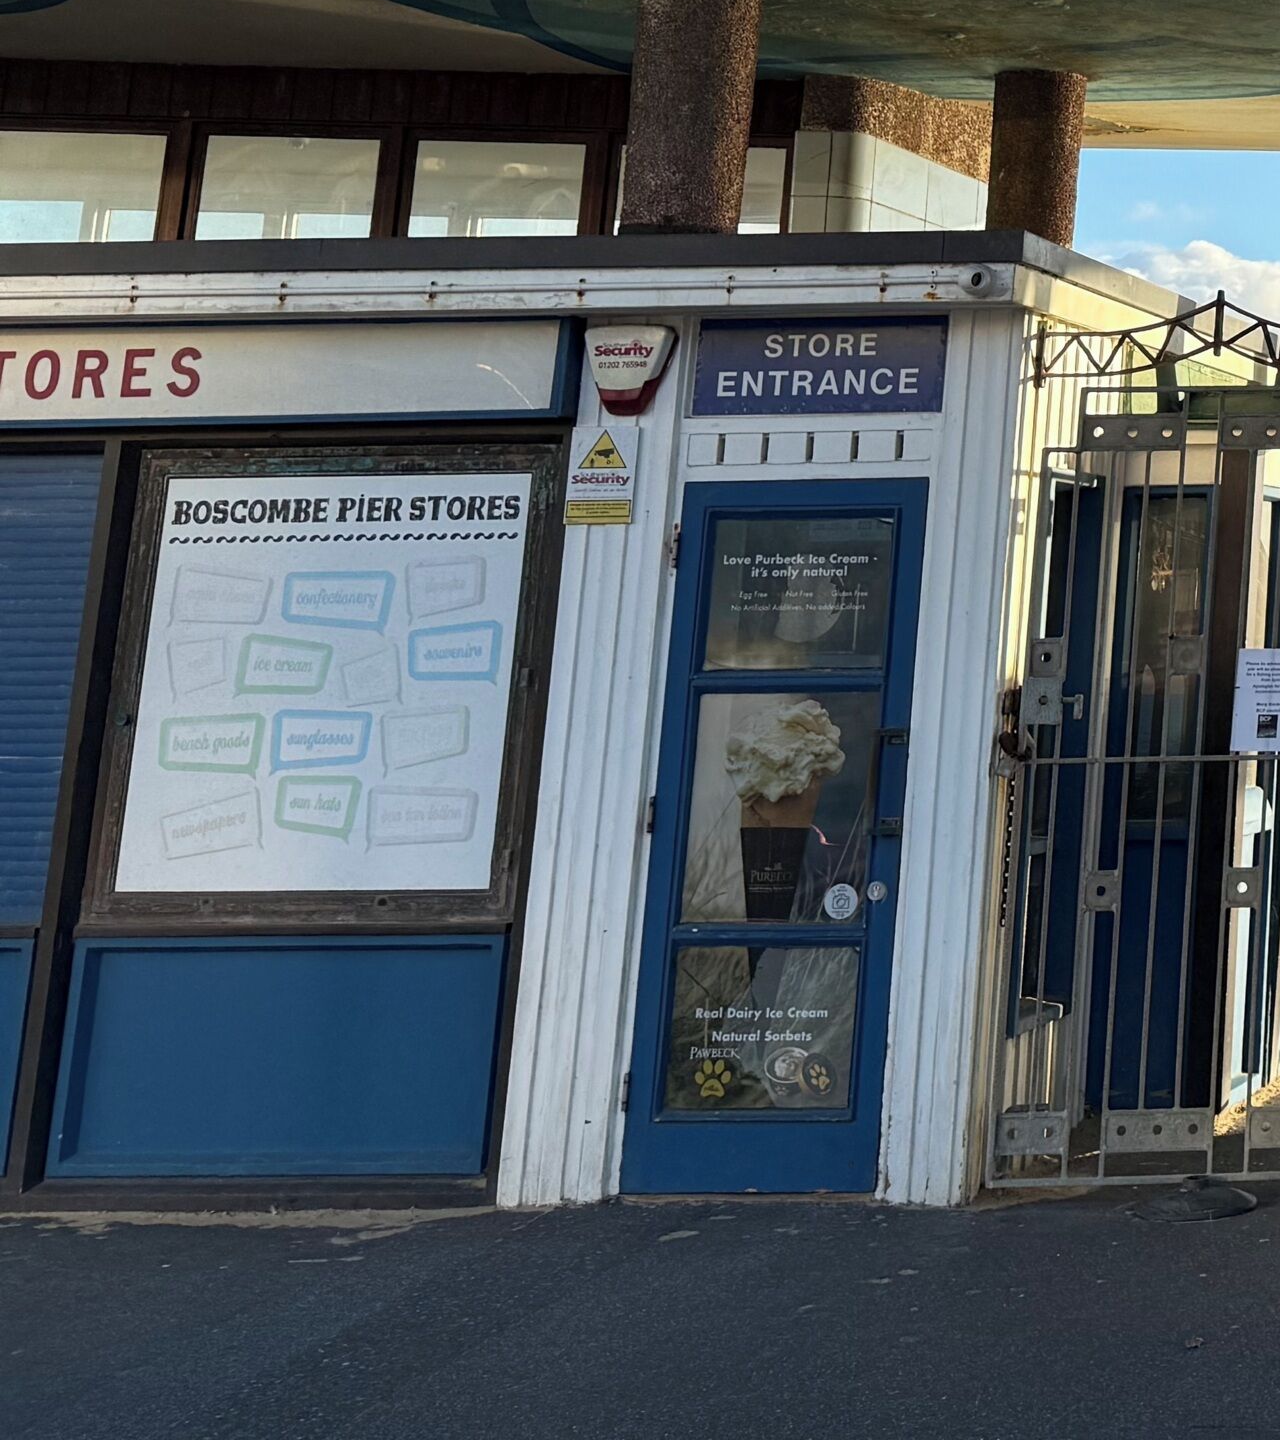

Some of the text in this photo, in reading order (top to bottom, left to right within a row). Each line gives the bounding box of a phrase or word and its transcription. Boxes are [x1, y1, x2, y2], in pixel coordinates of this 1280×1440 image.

[594, 343, 654, 359] Security
[764, 332, 878, 358] STORE
[598, 361, 619, 369] 01202
[716, 367, 919, 398] ENTRANCE
[571, 474, 630, 486] Security
[172, 497, 329, 525] BOSCOMBE
[409, 495, 521, 521] STORES
[723, 553, 869, 565] Love Purbeck Ice Cream
[771, 566, 800, 579] only
[803, 566, 848, 577] natural
[253, 654, 313, 674] ice cream
[172, 731, 251, 755] beach goods
[289, 789, 342, 812] sun hats
[695, 1007, 829, 1021] Real Dairy Ice Cream
[711, 1030, 812, 1042] Natural Sorbets
[689, 1046, 741, 1059] PAWBECK
